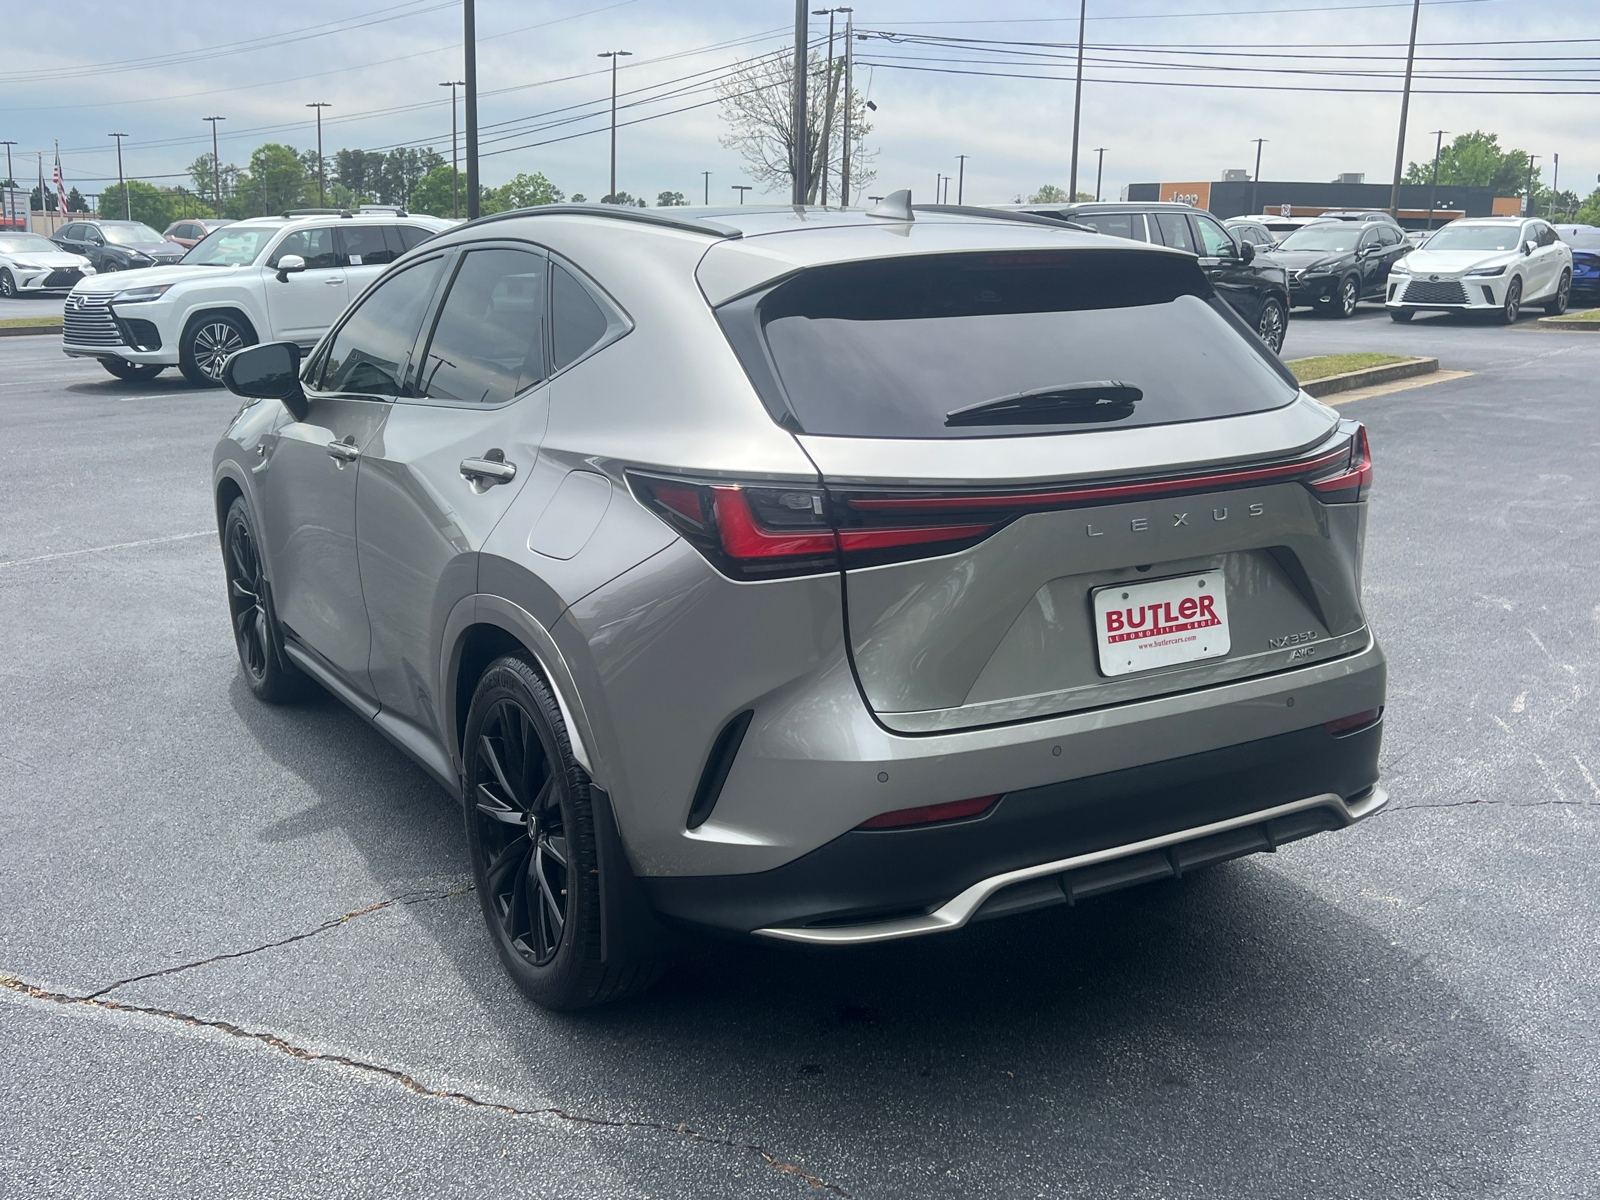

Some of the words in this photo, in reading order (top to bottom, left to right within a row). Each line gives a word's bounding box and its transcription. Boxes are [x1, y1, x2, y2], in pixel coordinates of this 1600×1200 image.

[1169, 191, 1199, 206] Jeep
[1086, 503, 1264, 537] LEXUS
[1108, 625, 1177, 644] AUTOMOTIVE
[1187, 618, 1219, 630] GROUP
[1138, 635, 1197, 650] www.butlercars.com
[1290, 646, 1315, 659] AWD
